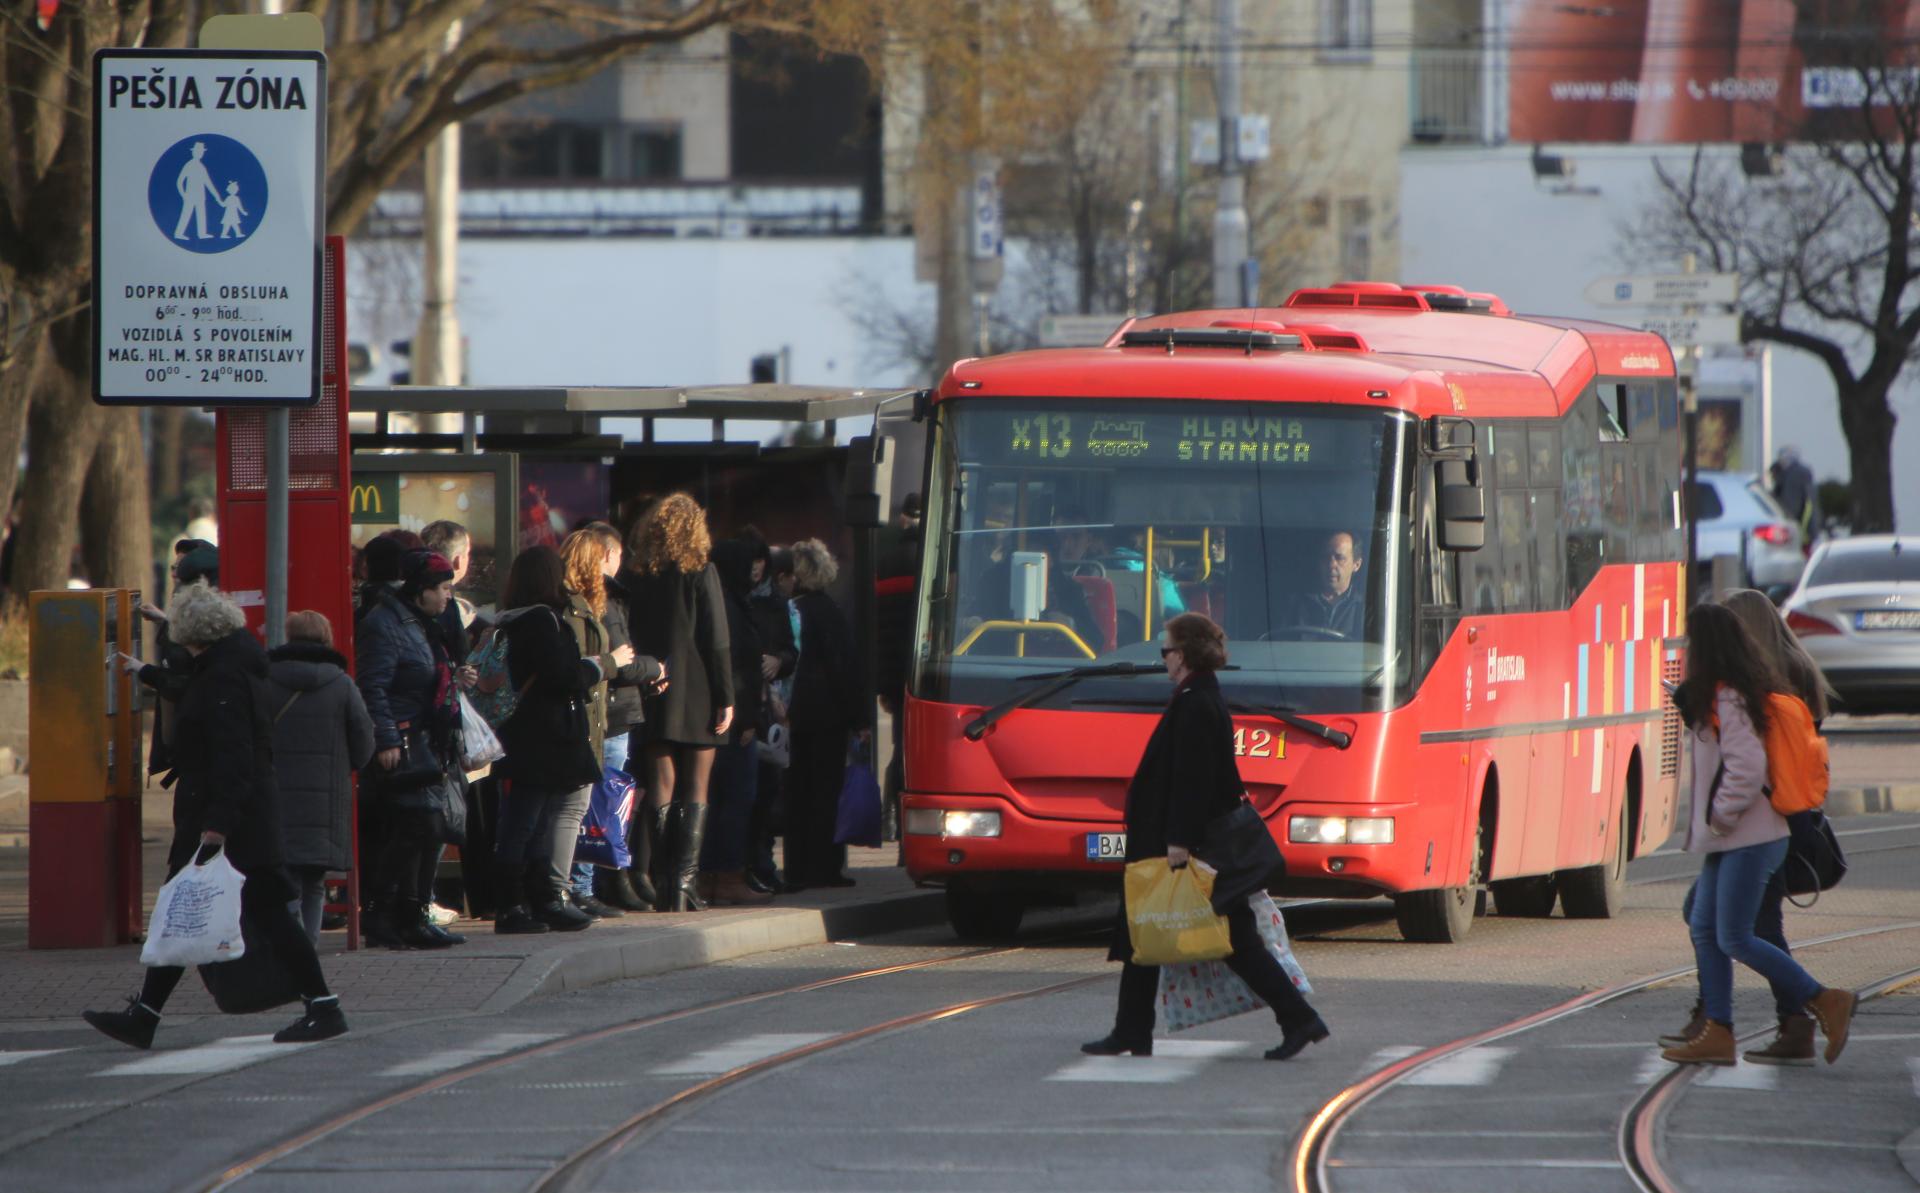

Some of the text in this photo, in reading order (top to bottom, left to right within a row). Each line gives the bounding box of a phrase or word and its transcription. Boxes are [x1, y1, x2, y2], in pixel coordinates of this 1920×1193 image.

[109, 67, 307, 110] PEŠIA ZÓNA
[125, 282, 289, 300] DOPRAVNÁ OBSLUHA
[122, 325, 292, 342] VOZIDLÁ S POVOLENÍM
[108, 348, 305, 363] MAG. HL. M. SR BRATISLAVY
[1012, 412, 1071, 458] X13
[1182, 417, 1304, 439] HLAVNA
